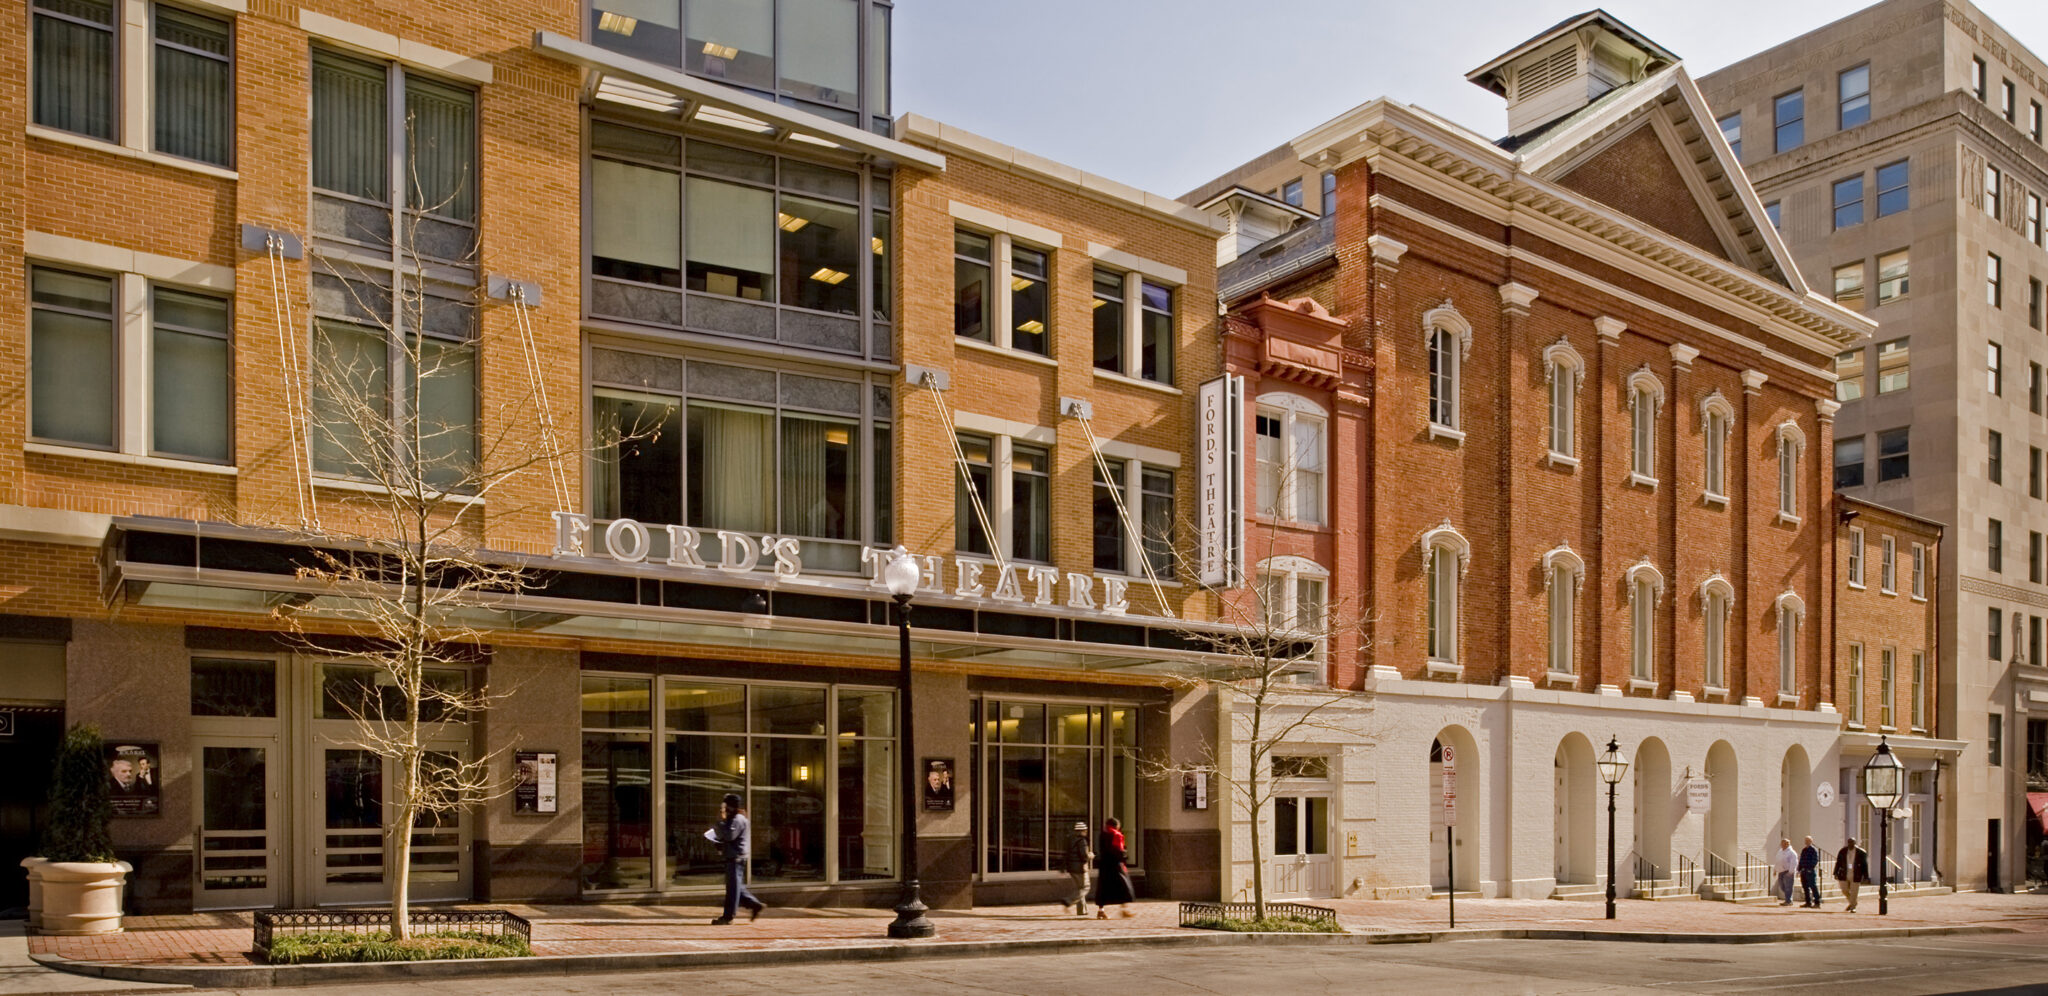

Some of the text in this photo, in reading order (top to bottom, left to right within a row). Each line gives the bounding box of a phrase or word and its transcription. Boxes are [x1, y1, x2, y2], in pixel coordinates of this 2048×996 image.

[1206, 395, 1217, 573] FORD'S THEATRE
[551, 511, 1130, 616] FORD'S THEATRE
